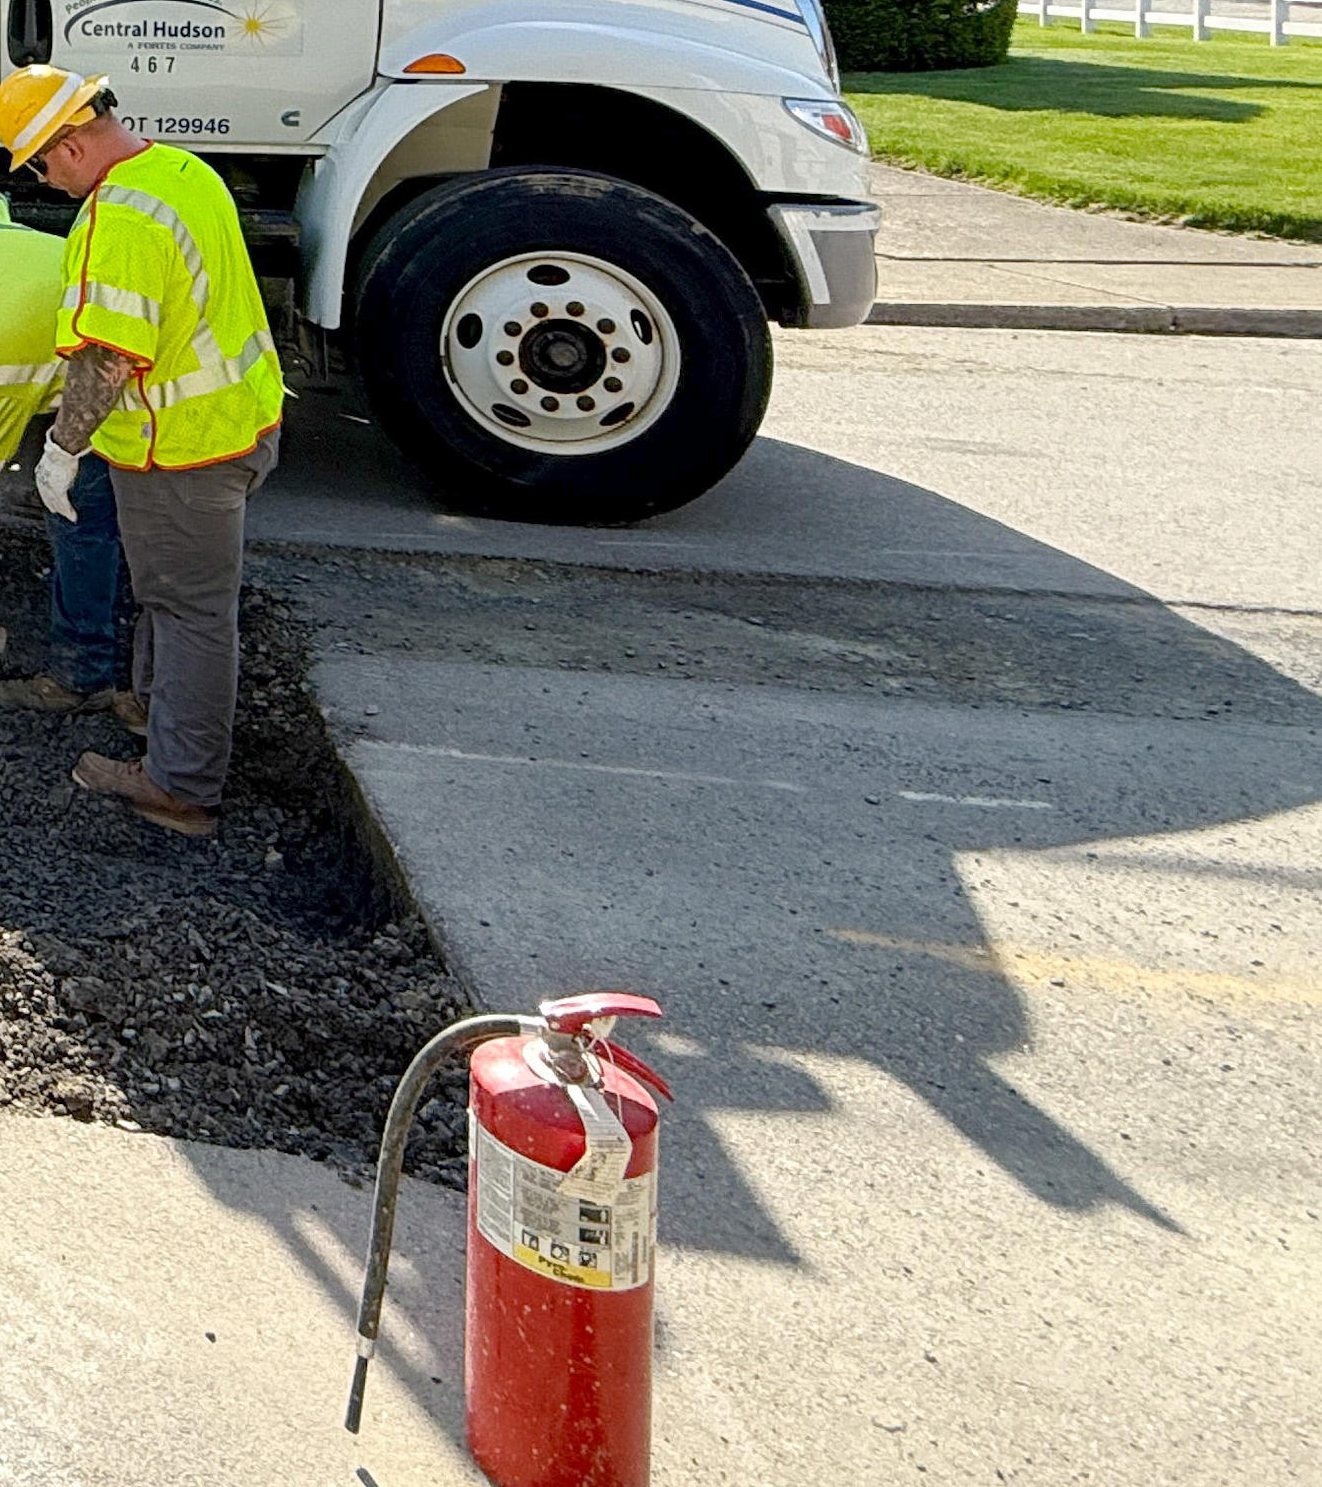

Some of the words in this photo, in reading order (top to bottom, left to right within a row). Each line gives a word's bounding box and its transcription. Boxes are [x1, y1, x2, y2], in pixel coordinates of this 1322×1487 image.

[81, 20, 147, 37] Central
[153, 21, 225, 38] Hudson
[121, 116, 148, 132] OT
[154, 117, 230, 134] 129946
